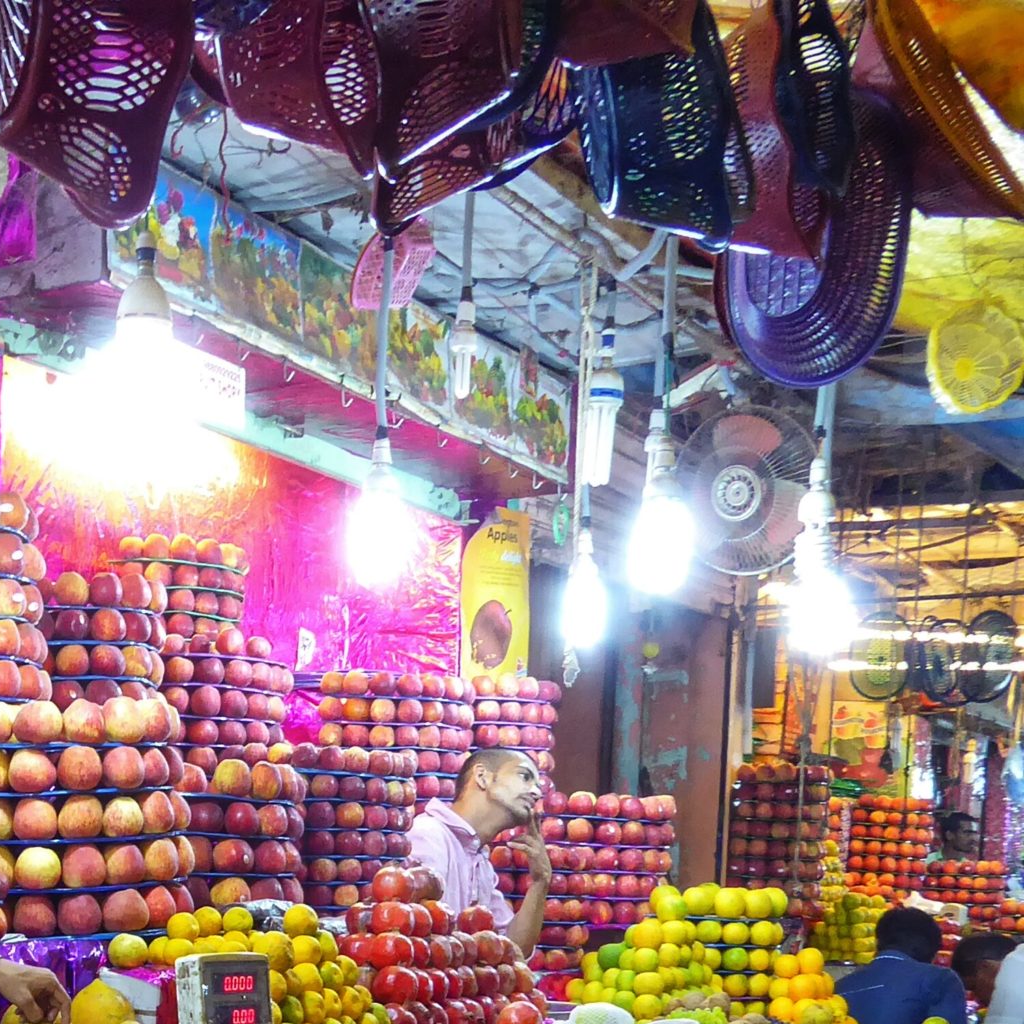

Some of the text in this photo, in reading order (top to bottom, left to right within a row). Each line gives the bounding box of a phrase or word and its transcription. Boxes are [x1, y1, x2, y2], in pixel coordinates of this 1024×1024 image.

[487, 527, 518, 544] Apples
[224, 975, 254, 992] 0.000
[232, 1008, 256, 1024] 0.00
